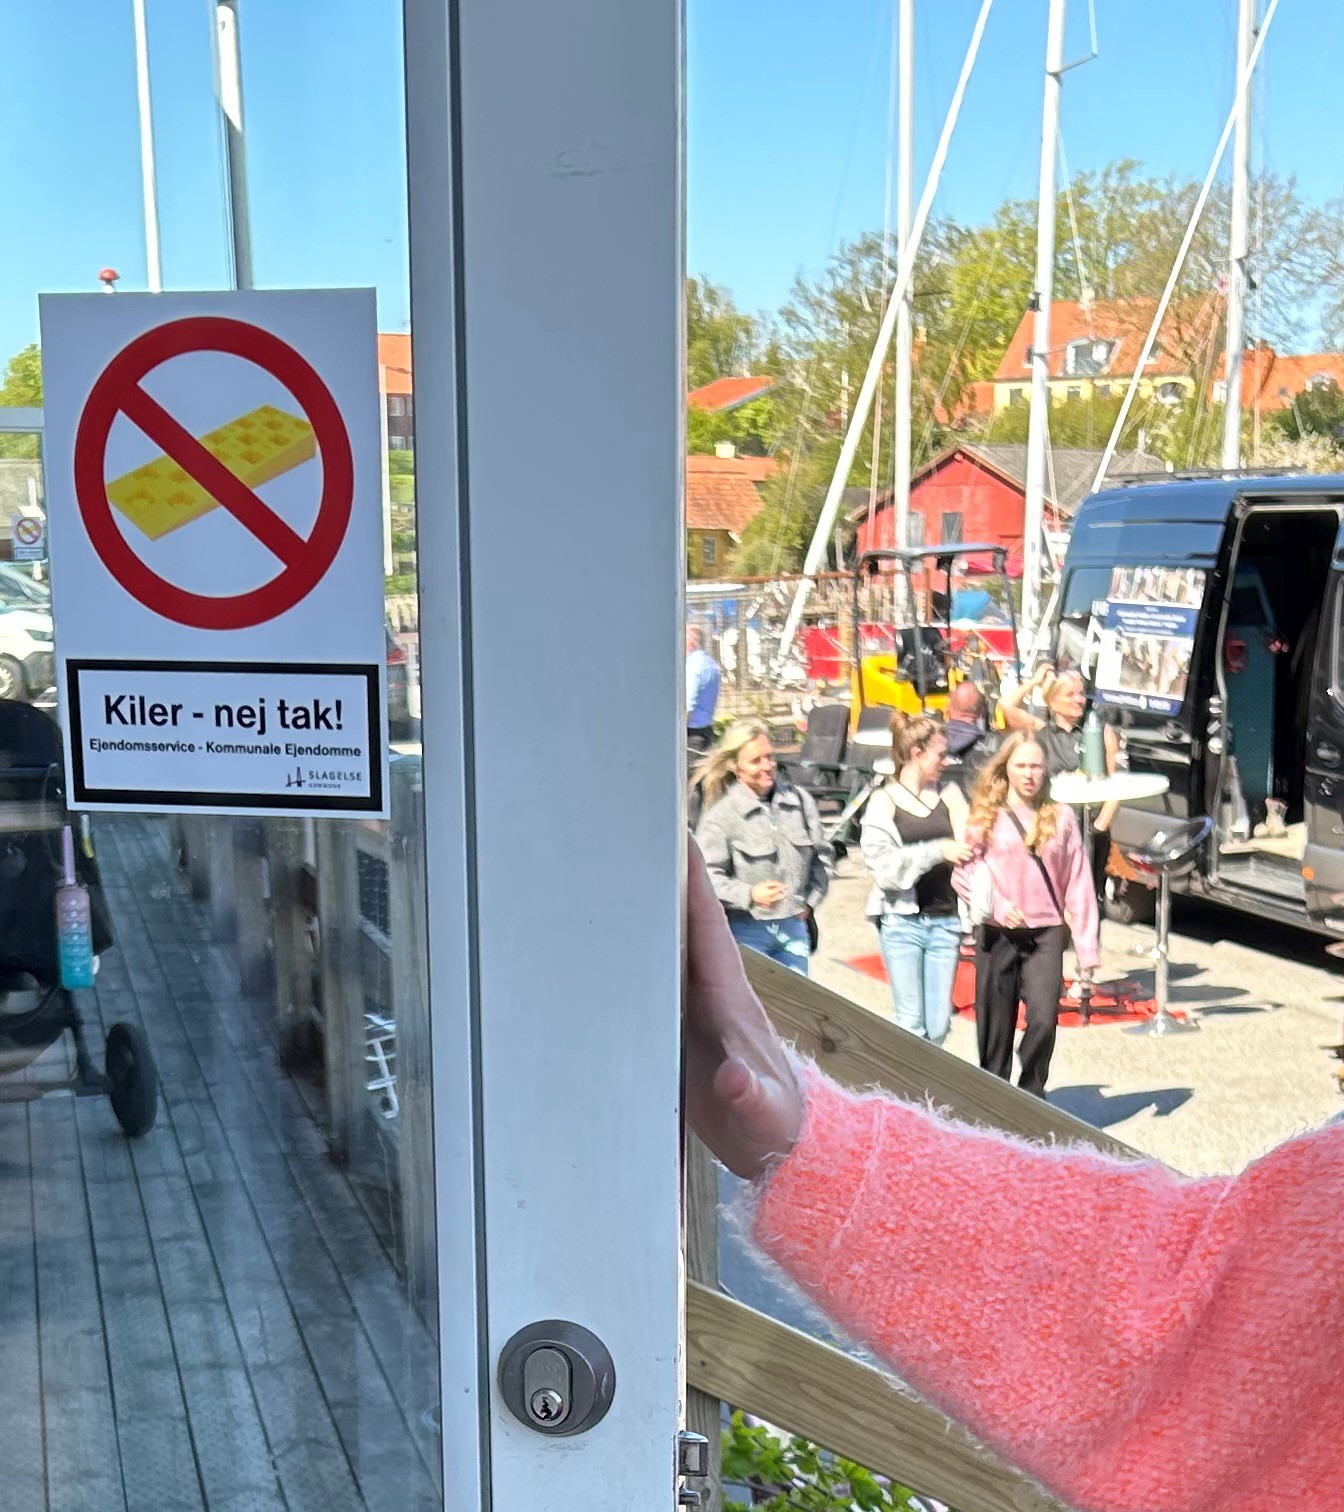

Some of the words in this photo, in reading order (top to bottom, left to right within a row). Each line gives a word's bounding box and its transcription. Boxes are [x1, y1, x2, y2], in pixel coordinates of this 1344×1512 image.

[104, 694, 183, 727] Kiler
[214, 697, 267, 736] nej
[277, 698, 343, 731] tak!
[89, 738, 196, 754] Ejendomsservice
[205, 741, 282, 756] Kommunale
[284, 743, 362, 759] Ejendomme
[308, 770, 362, 782] SLAGELSE
